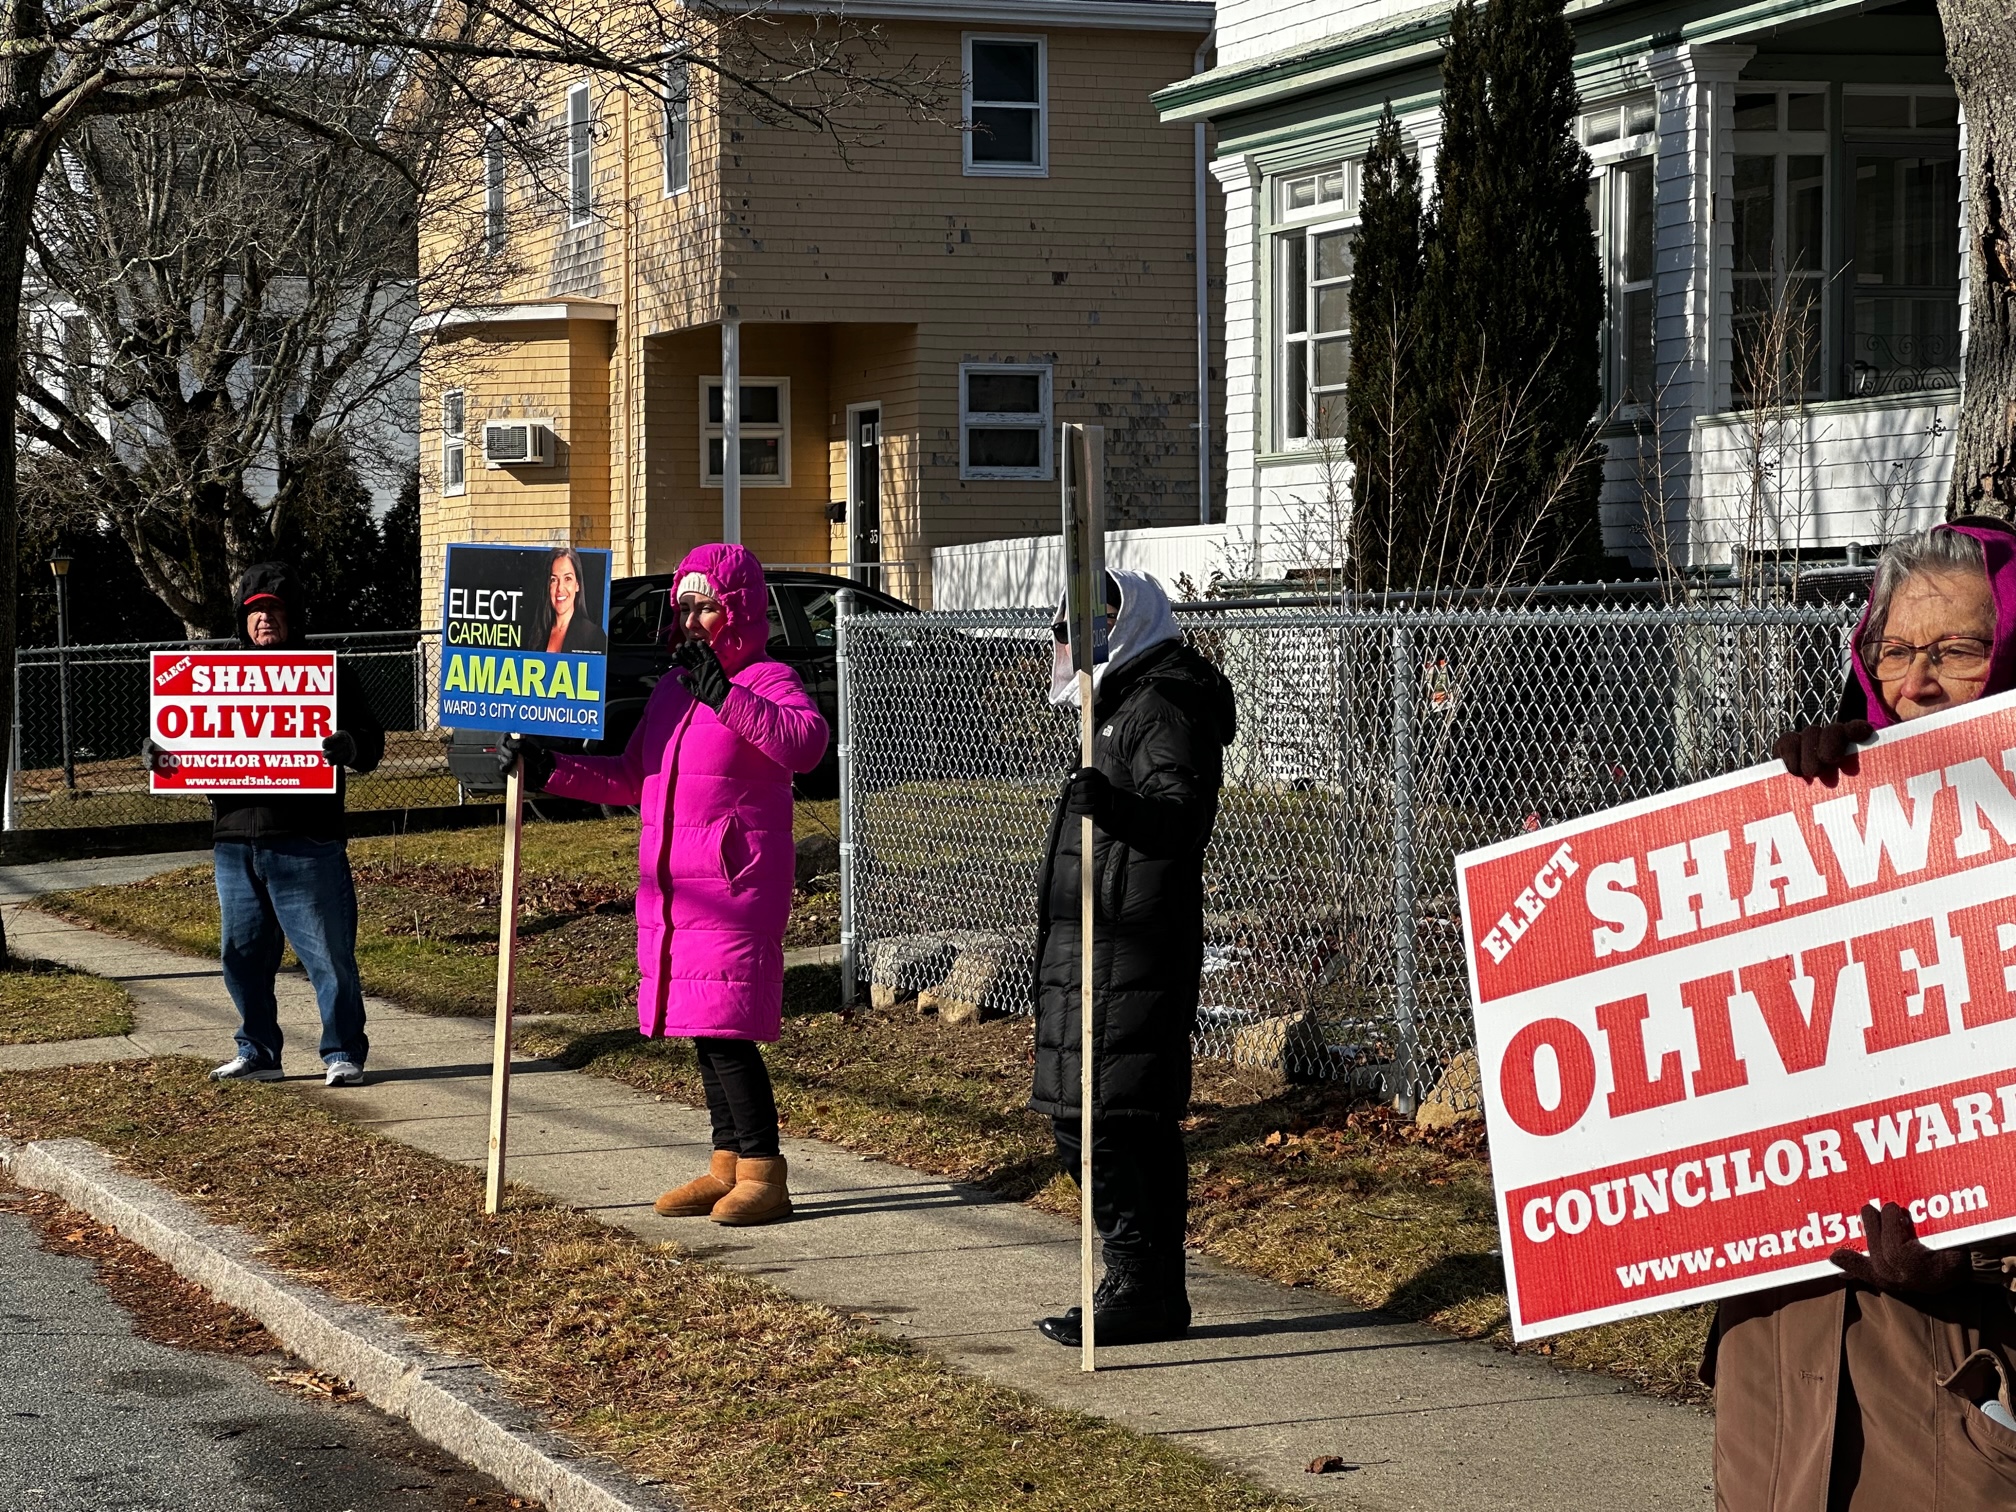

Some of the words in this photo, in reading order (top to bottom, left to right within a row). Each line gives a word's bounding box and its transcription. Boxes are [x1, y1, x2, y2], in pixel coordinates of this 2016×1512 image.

[448, 588, 523, 622] ELECT
[447, 621, 521, 647] CARMEN
[156, 656, 192, 686] ELECT
[192, 665, 333, 693] SHAWN
[444, 654, 600, 701] AMARAL
[156, 704, 333, 739] OLIVER
[443, 699, 477, 715] WARD
[479, 702, 487, 717] 3
[489, 702, 516, 719] CITY
[519, 704, 598, 725] COUNCILOR
[158, 754, 260, 768] COUNCILOR
[263, 754, 319, 768] WARD
[185, 775, 300, 786] www.ward3nb.com
[1585, 748, 2016, 958] SHAWN
[1480, 842, 1580, 965] ELECT
[1522, 1128, 1848, 1243] COUNCILOR
